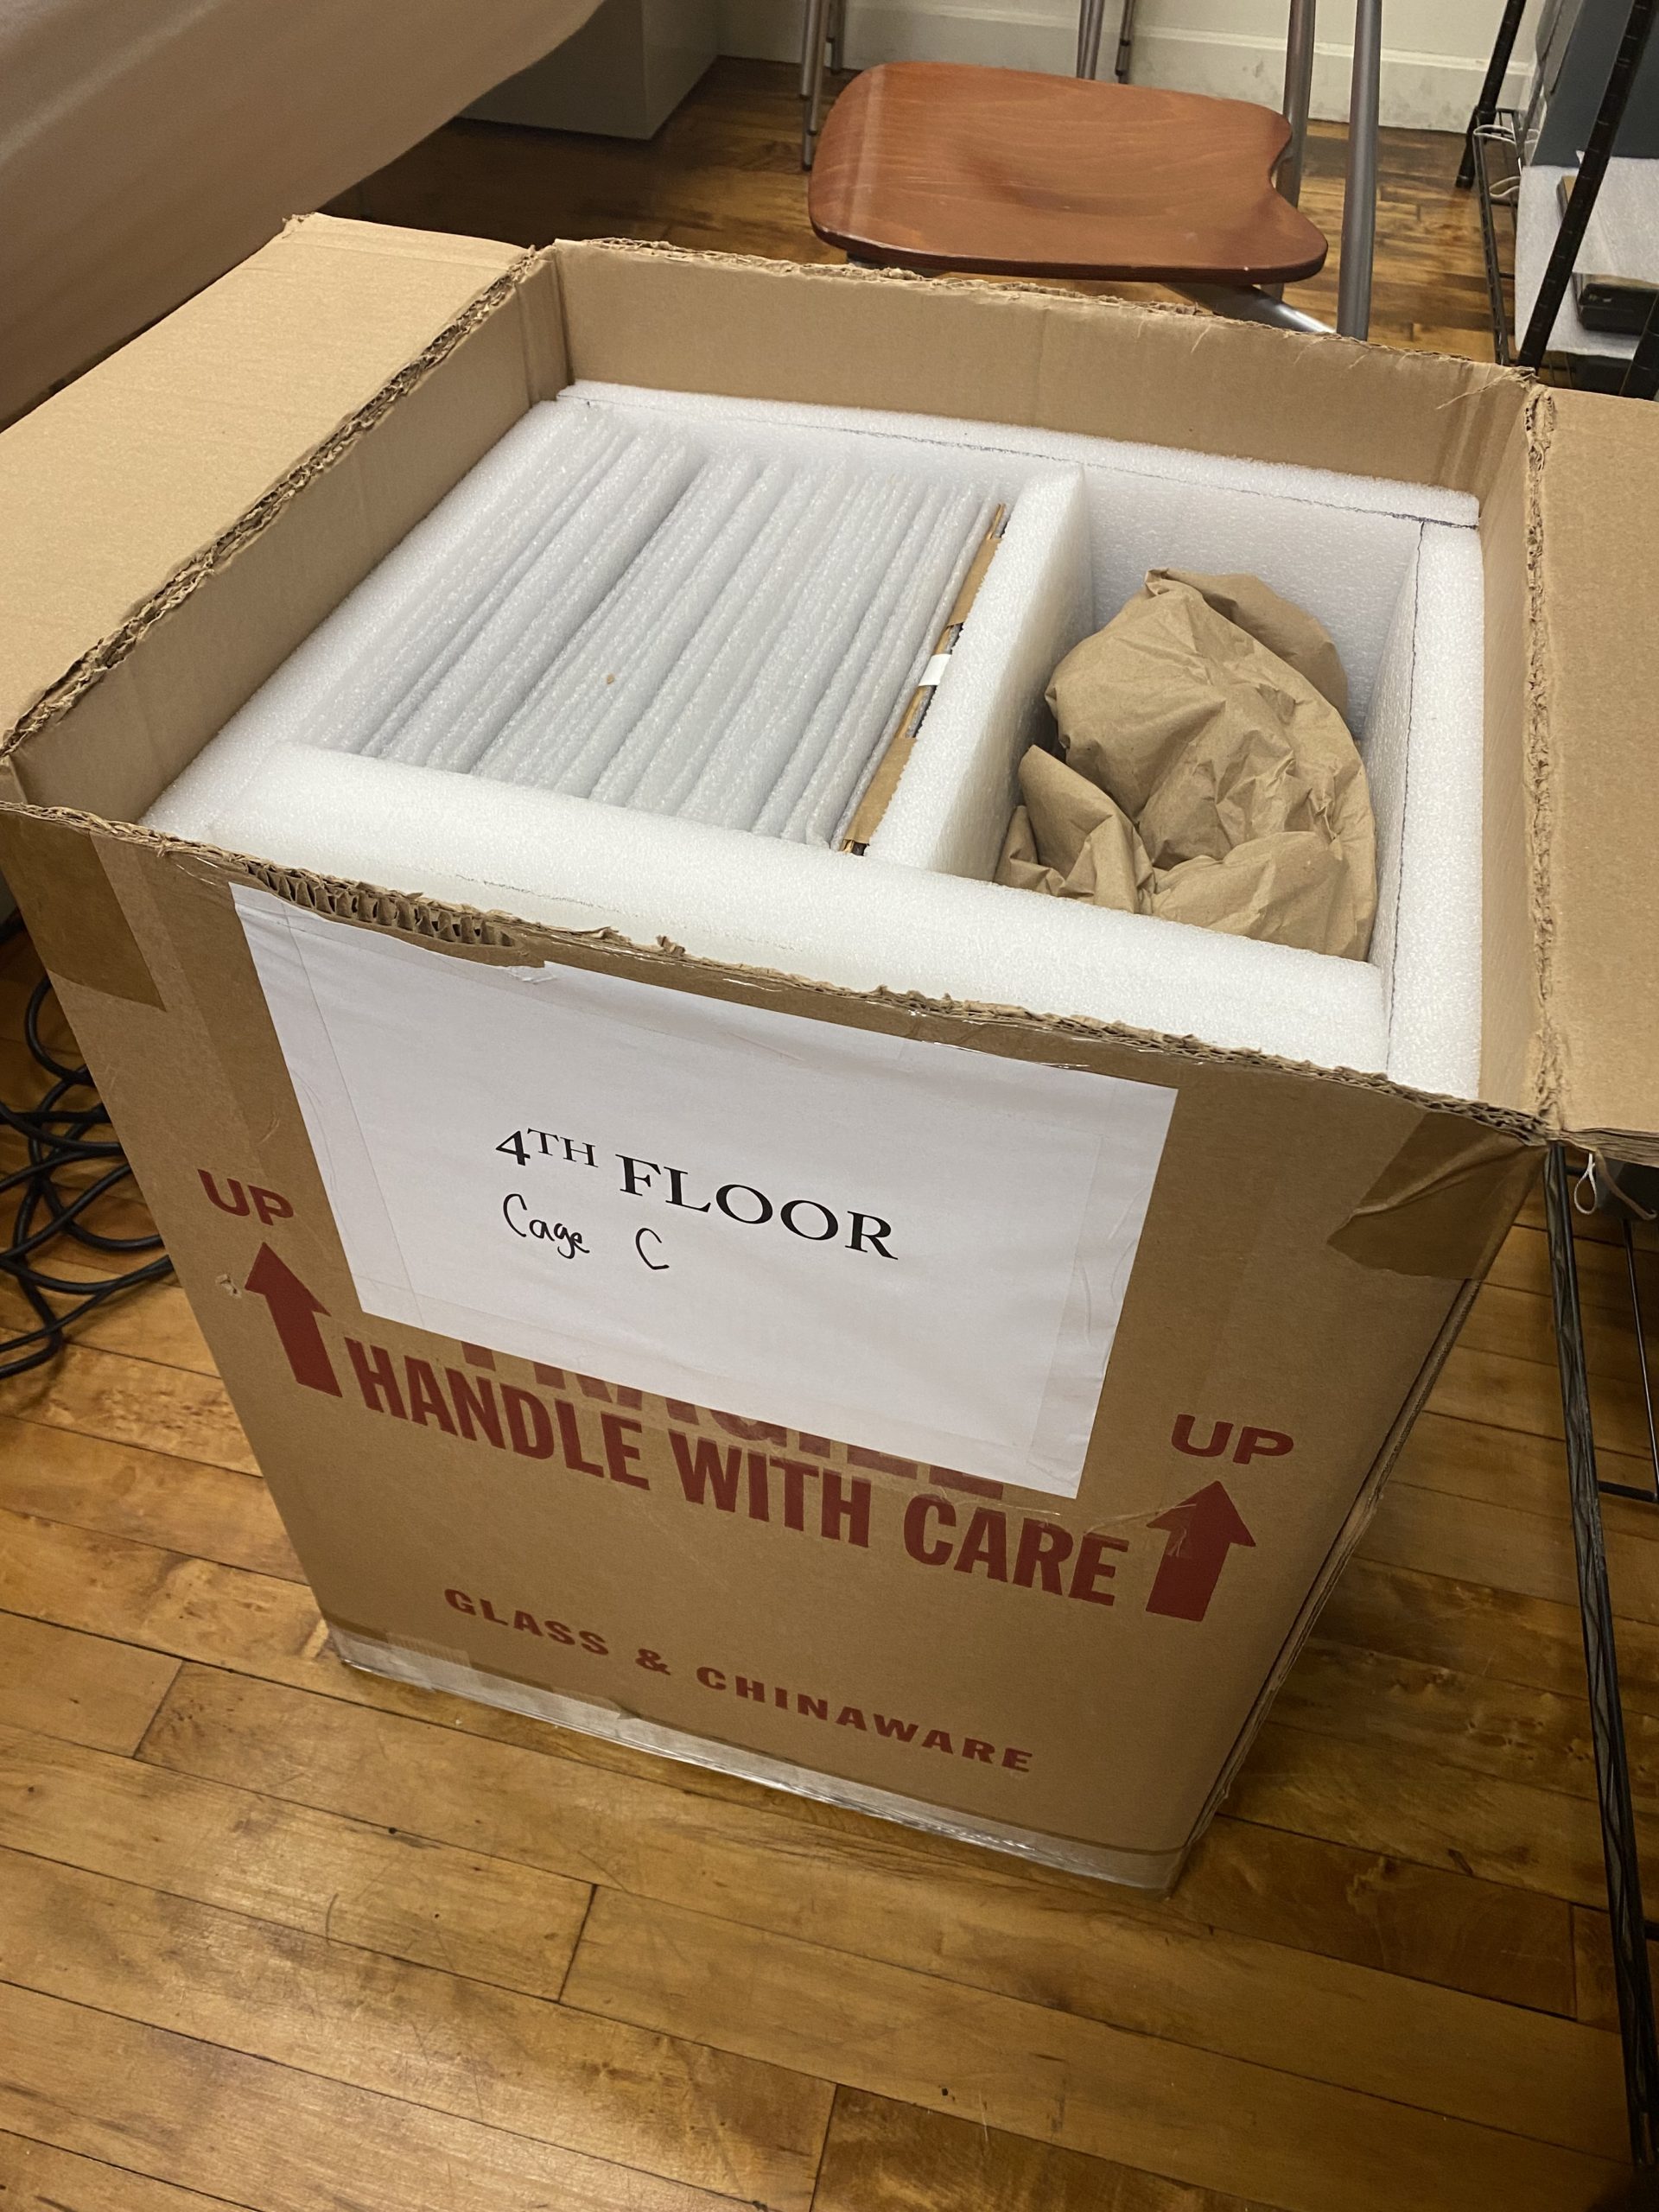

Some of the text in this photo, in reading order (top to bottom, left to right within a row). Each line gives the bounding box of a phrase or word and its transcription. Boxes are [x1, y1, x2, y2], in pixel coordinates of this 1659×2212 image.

[197, 1168, 295, 1226] UP
[494, 1127, 899, 1262] 4TH FLOOR
[502, 1192, 671, 1271] Cage C
[345, 1337, 650, 1490] HANDLE
[667, 1427, 873, 1549] WITH
[903, 1492, 1130, 1607] CARE
[1171, 1414, 1295, 1466] UP
[444, 1588, 1034, 1775] GLASS & CHINAWARE
